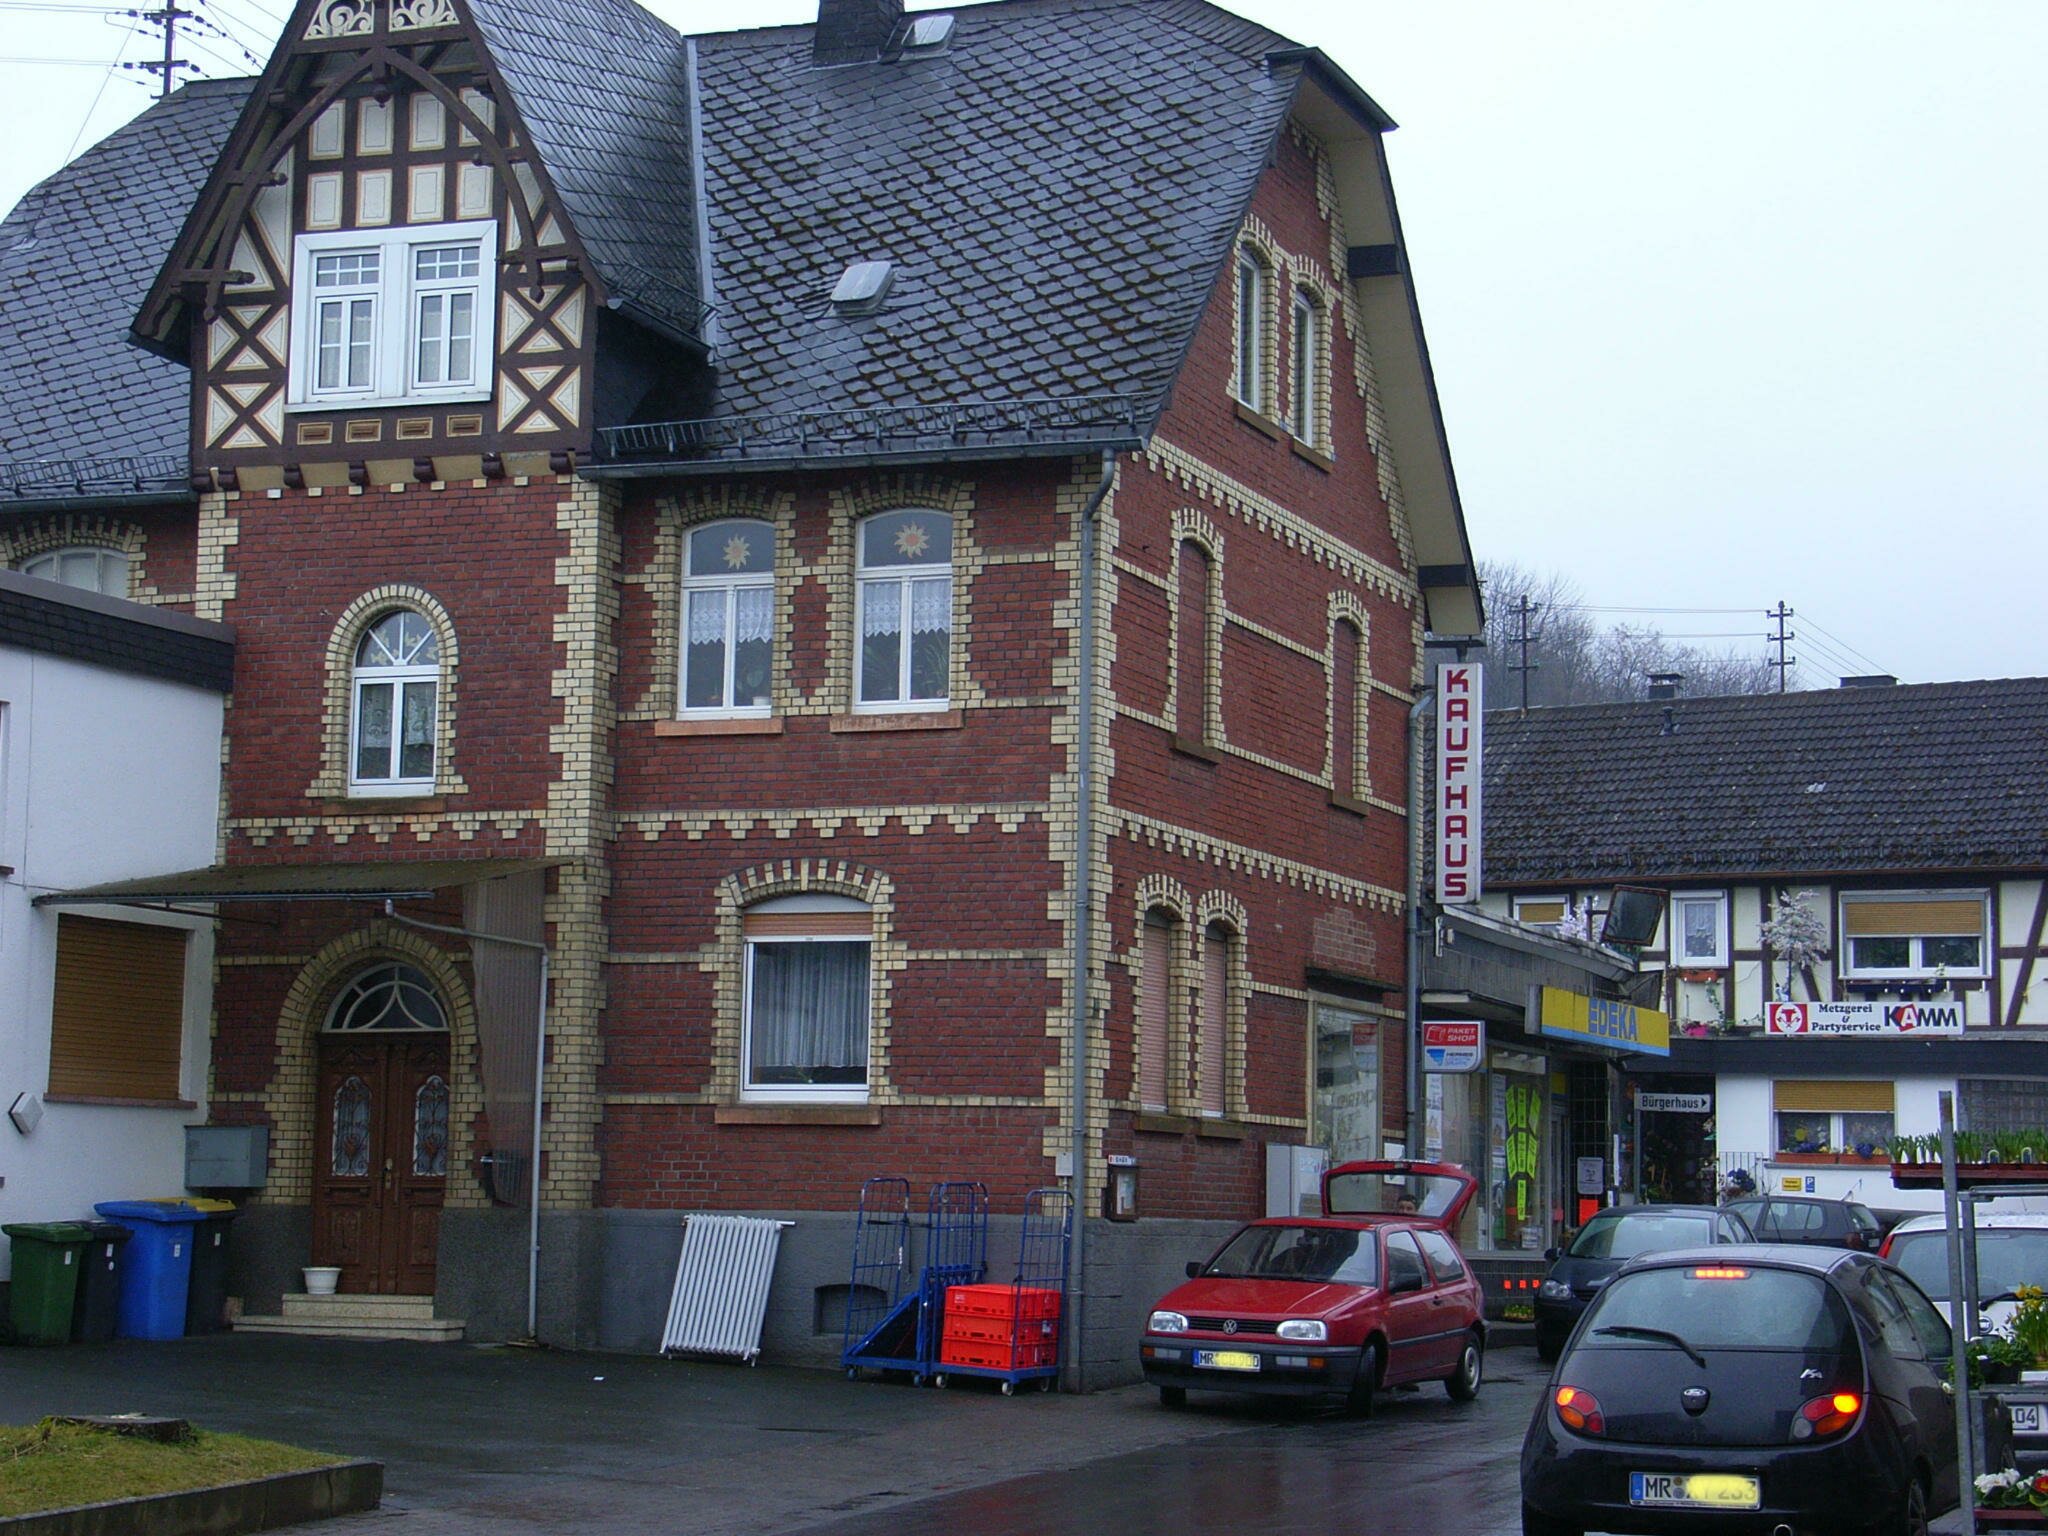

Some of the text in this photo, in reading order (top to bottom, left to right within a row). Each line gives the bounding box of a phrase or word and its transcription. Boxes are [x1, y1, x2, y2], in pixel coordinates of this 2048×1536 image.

[1444, 669, 1469, 897] KAUFHAUS
[1818, 1003, 1873, 1015] Metzgerei
[1883, 1004, 1958, 1031] KAMM
[1588, 996, 1638, 1041] EDEKA
[1811, 1021, 1881, 1032] Partyservice
[1642, 1095, 1699, 1110] Bürgerhaus
[1199, 1353, 1214, 1365] MR
[1645, 1477, 1671, 1498] MR
